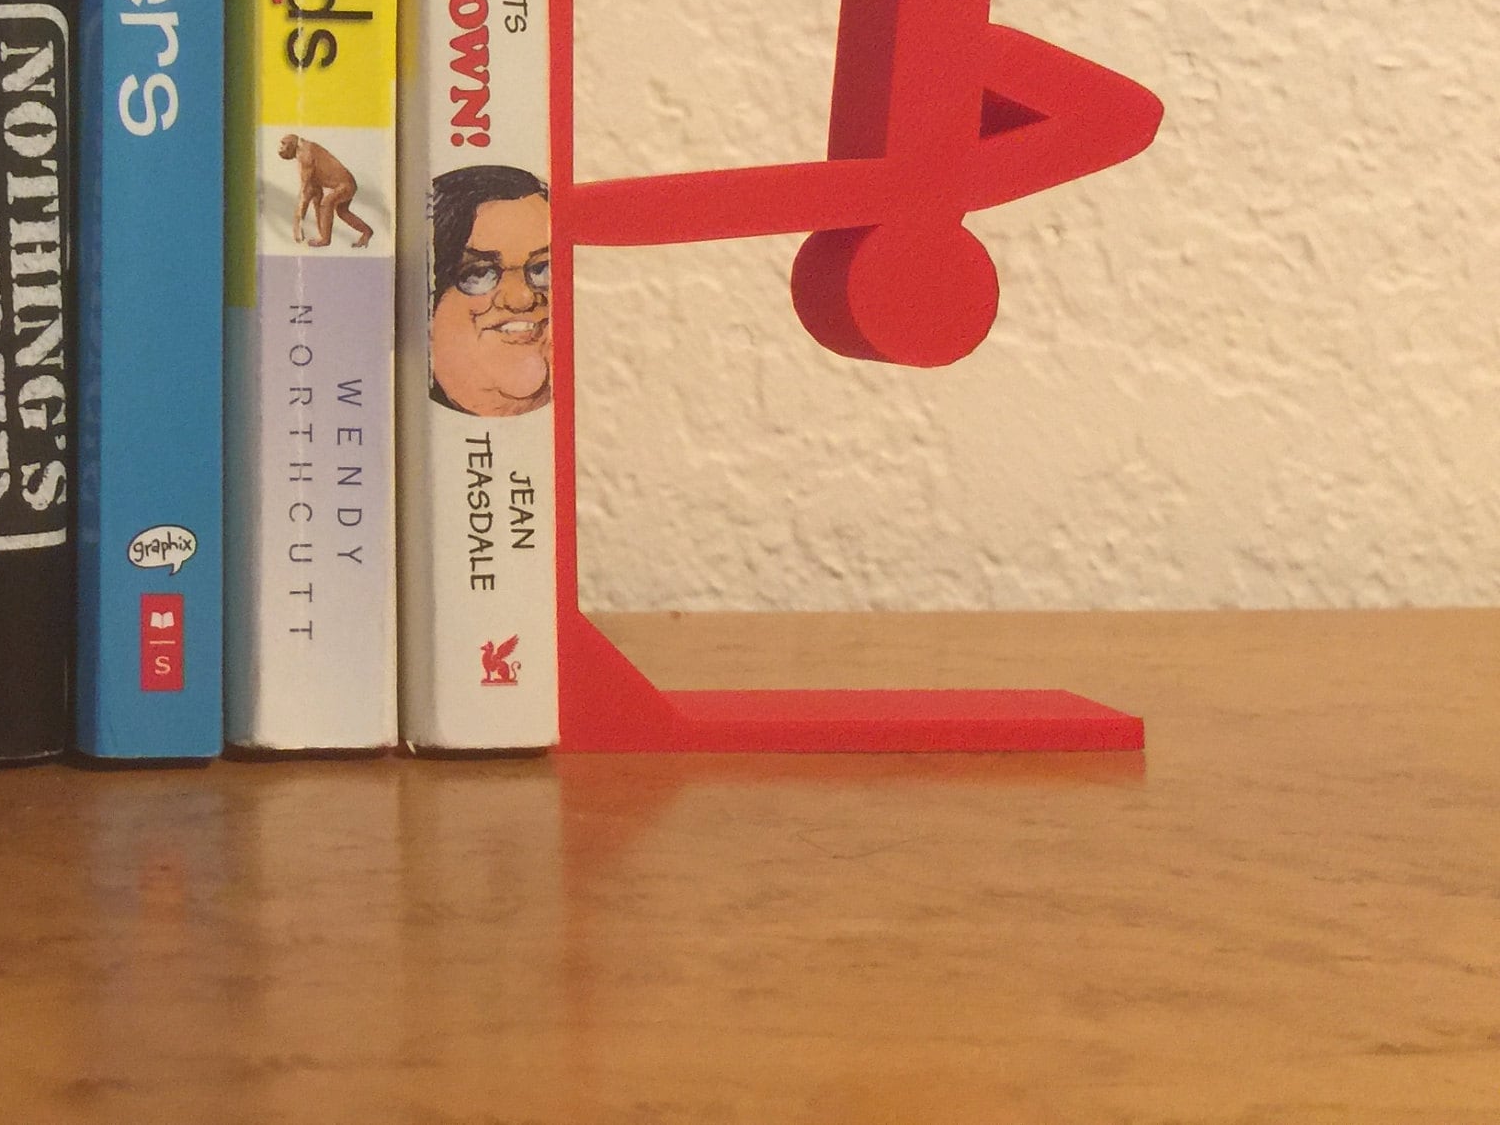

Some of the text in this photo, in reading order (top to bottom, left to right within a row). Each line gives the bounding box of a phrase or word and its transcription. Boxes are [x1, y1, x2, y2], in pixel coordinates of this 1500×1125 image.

[0, 41, 67, 511] NOTHING'S
[133, 531, 193, 563] graphix
[288, 304, 313, 640] NORTHCUTT
[336, 378, 363, 565] WENDY
[466, 432, 494, 592] TEASDALE
[509, 470, 535, 550] JEAN
[154, 656, 171, 675] S
